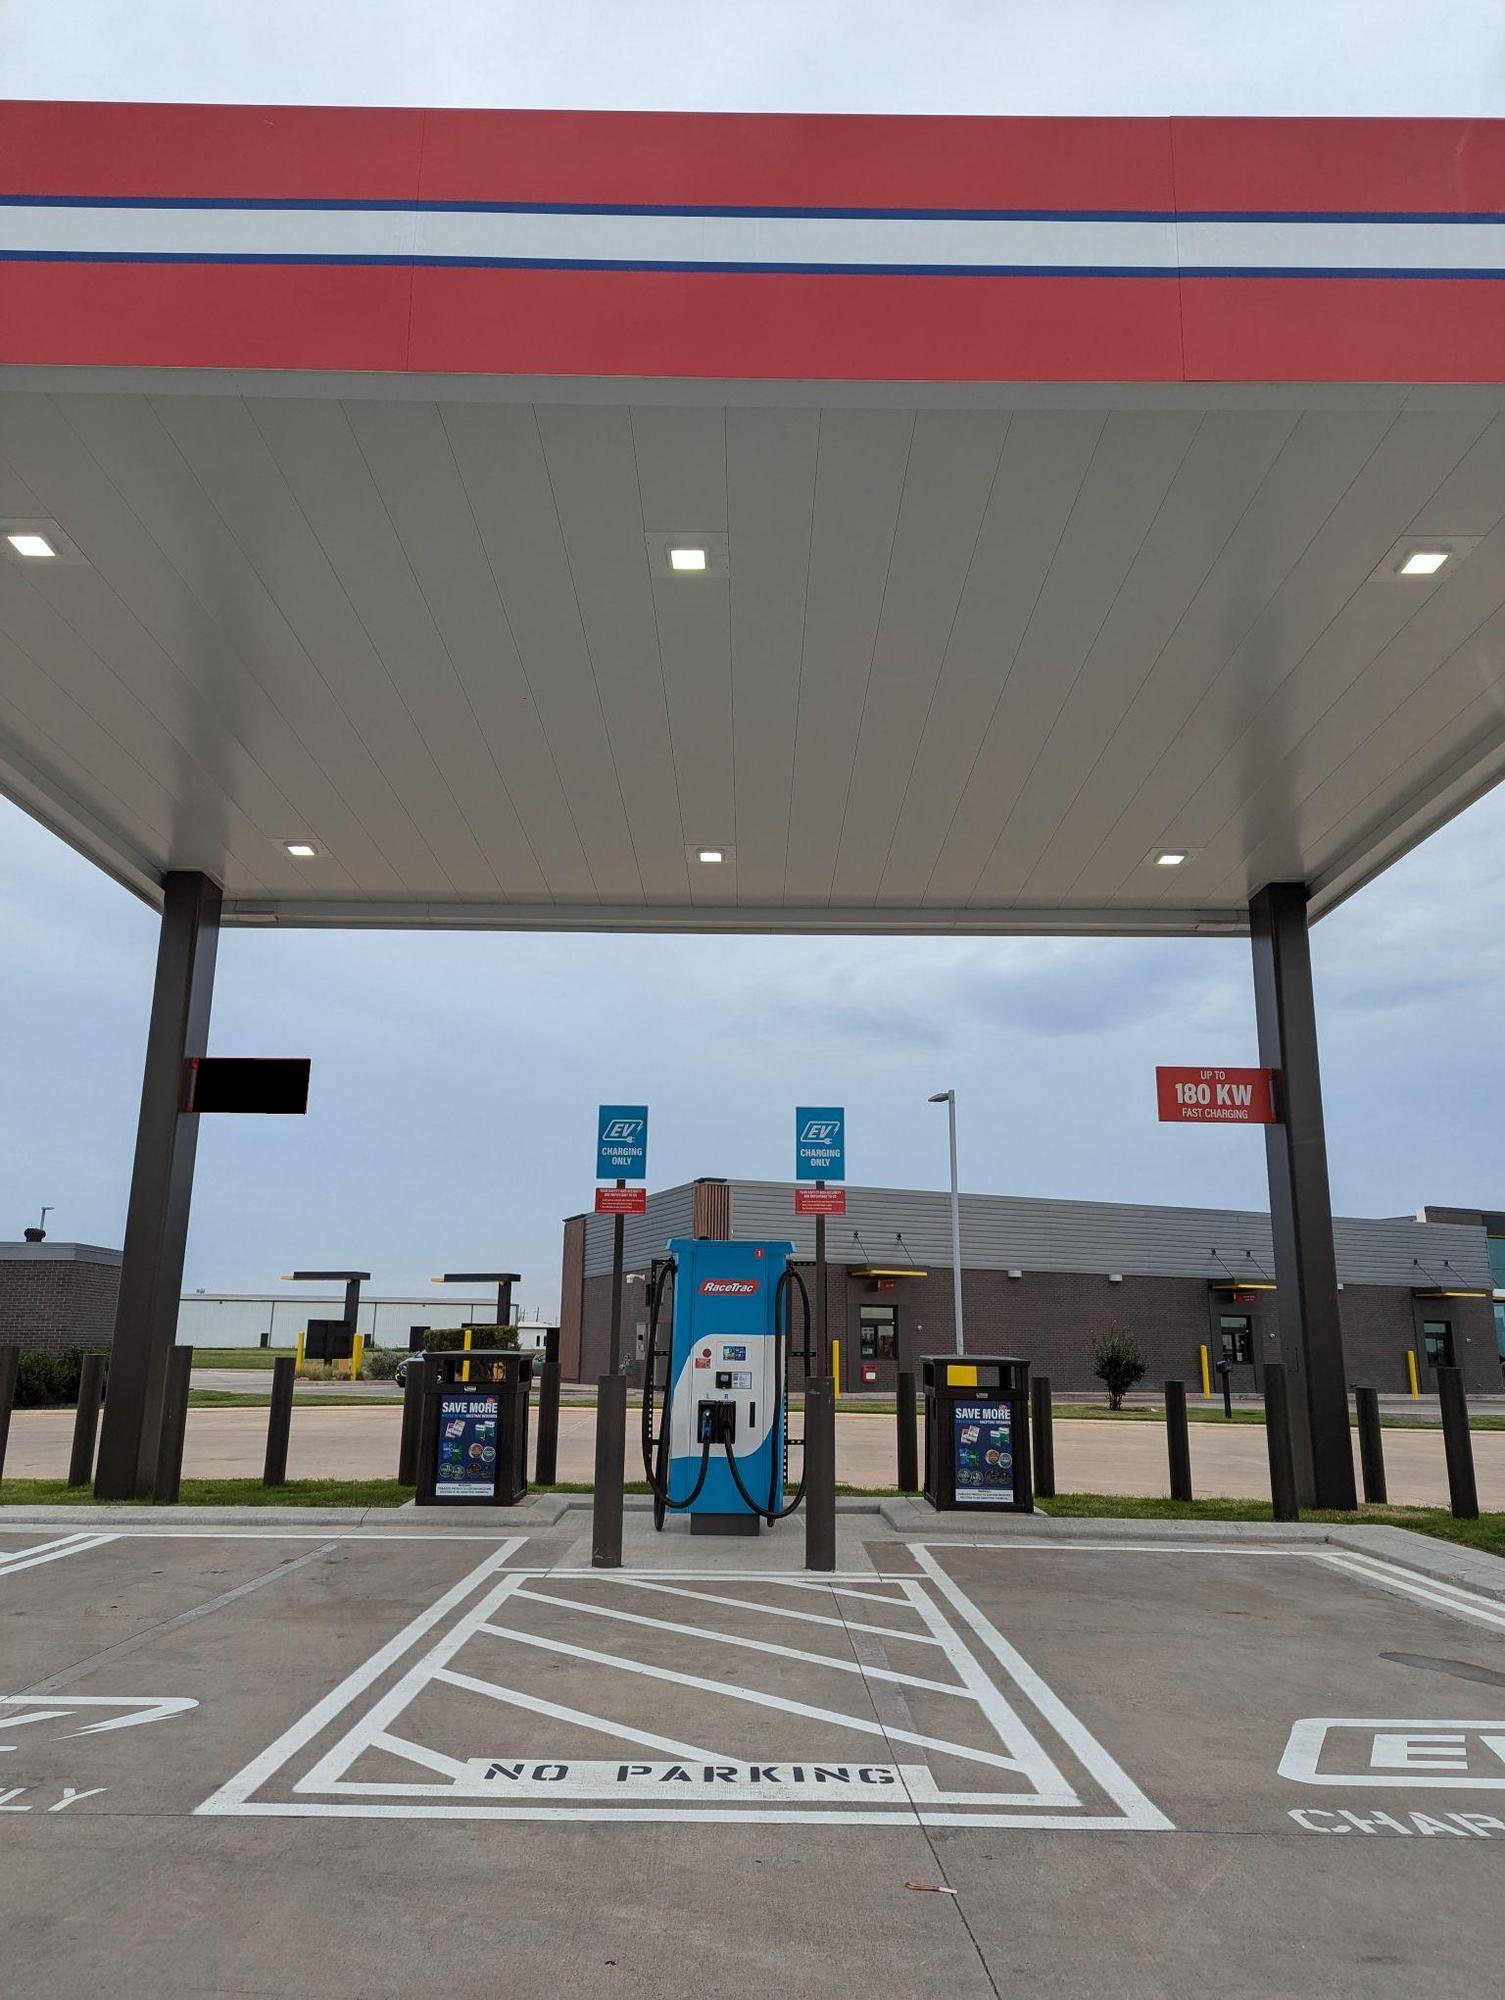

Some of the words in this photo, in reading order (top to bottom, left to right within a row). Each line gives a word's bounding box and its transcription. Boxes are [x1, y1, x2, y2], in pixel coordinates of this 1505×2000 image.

[1200, 1070, 1212, 1080] UP
[1215, 1071, 1226, 1080] TO
[1175, 1083, 1211, 1105] 180
[1216, 1084, 1253, 1106] KW
[1182, 1108, 1203, 1118] FAST
[1204, 1108, 1248, 1119] CHARGING
[610, 1123, 636, 1137] EV
[807, 1125, 833, 1138] EV
[601, 1147, 642, 1156] CHARGING
[800, 1148, 841, 1158] CHARGING
[611, 1157, 632, 1166] ONLY
[810, 1158, 831, 1167] ONLY
[703, 1282, 754, 1292] RaceTrac
[442, 1401, 467, 1413] SAVE
[469, 1402, 498, 1414] MORE
[955, 1408, 980, 1419] SAVE
[982, 1408, 1011, 1420] MORE
[1370, 1733, 1505, 1770] E
[483, 1763, 570, 1782] NO
[616, 1765, 896, 1785] PARKING
